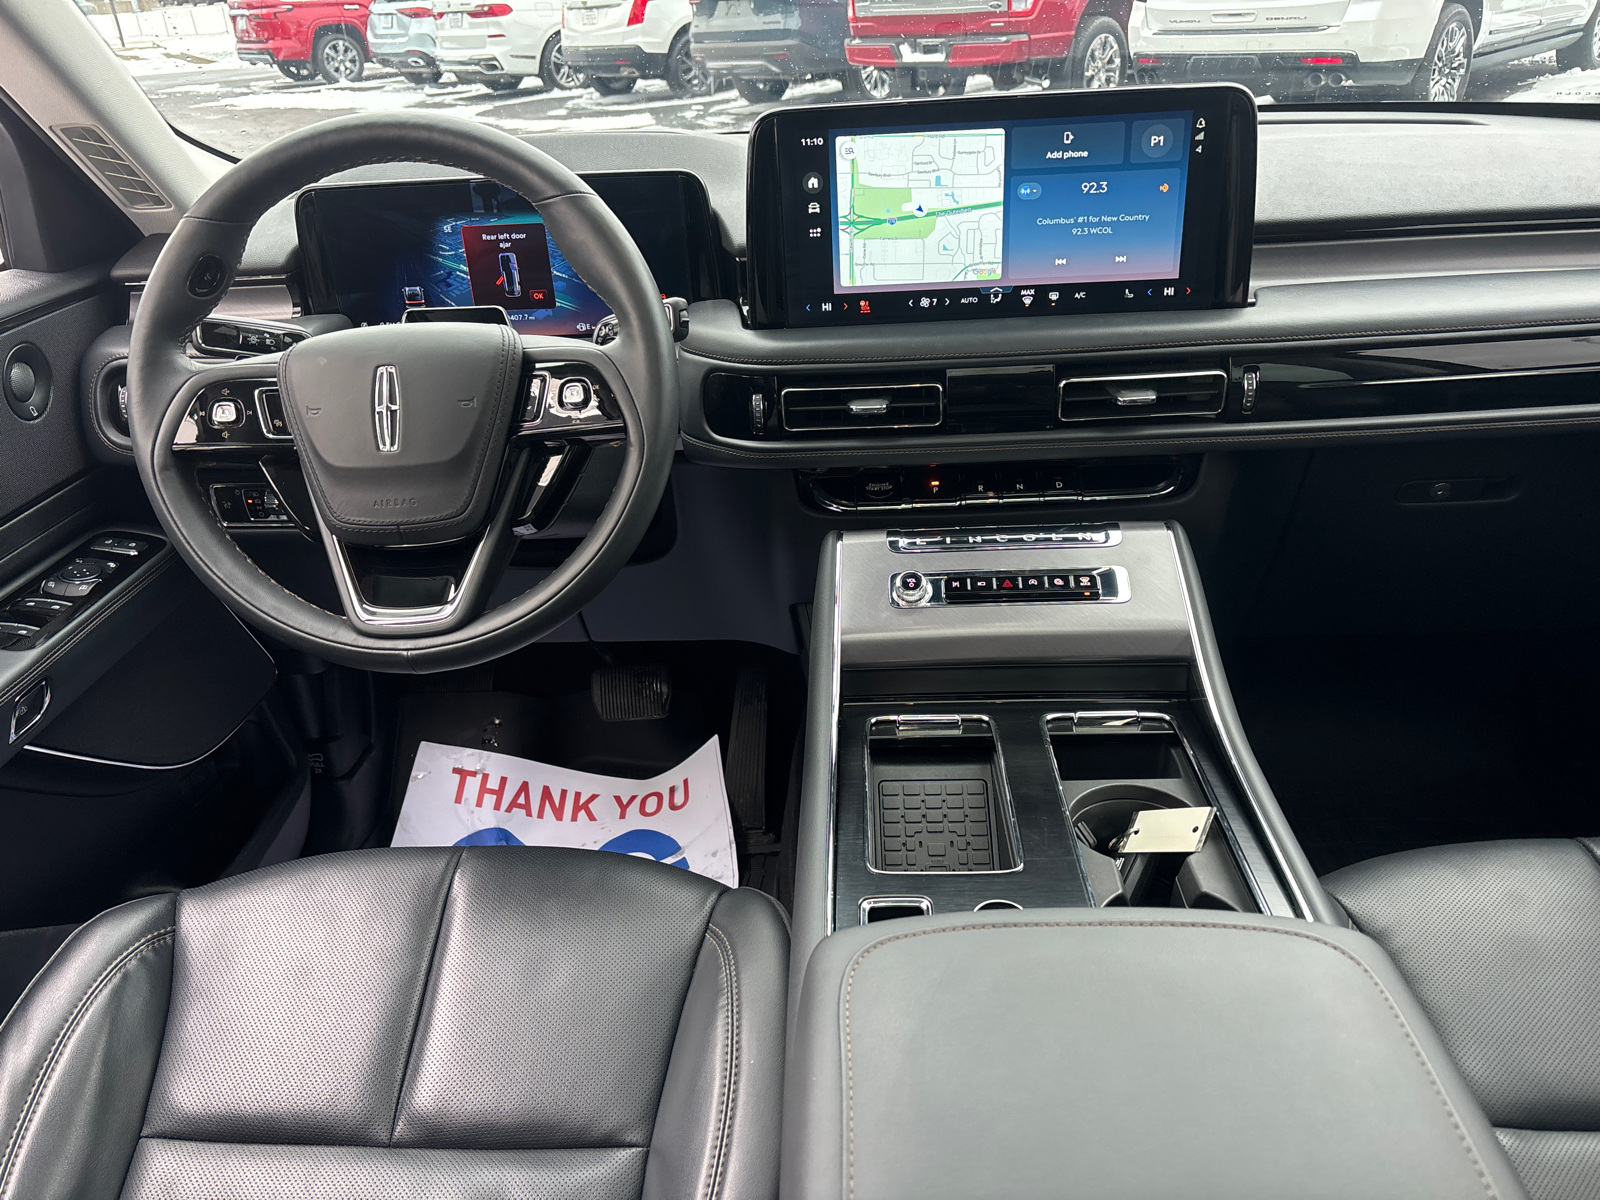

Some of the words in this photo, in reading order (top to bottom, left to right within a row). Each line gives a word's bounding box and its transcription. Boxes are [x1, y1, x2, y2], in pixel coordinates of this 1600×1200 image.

[800, 137, 824, 146] 11:10
[1150, 135, 1164, 147] P1
[1046, 151, 1062, 159] Add
[1063, 150, 1088, 160] phone
[1081, 181, 1108, 194] 92.3
[1077, 216, 1088, 224] #1
[1088, 215, 1100, 223] for
[1101, 215, 1118, 223] New
[1119, 213, 1150, 223] Country
[443, 225, 453, 233] SE
[1071, 227, 1089, 235] 92.3
[1089, 227, 1113, 235] WCOL
[482, 233, 497, 241] Rear
[497, 232, 510, 240] left
[510, 232, 527, 240] door
[499, 241, 512, 249] ajar
[1074, 291, 1086, 299] A/C
[1164, 287, 1175, 296] HI
[960, 296, 978, 304] AUTO
[821, 302, 832, 311] HI
[932, 486, 939, 494] P
[978, 484, 984, 492] R
[373, 497, 418, 509] AIRBAG
[916, 532, 1092, 545] LINCOLN
[451, 767, 601, 823] THANK
[612, 777, 690, 820] YOU
